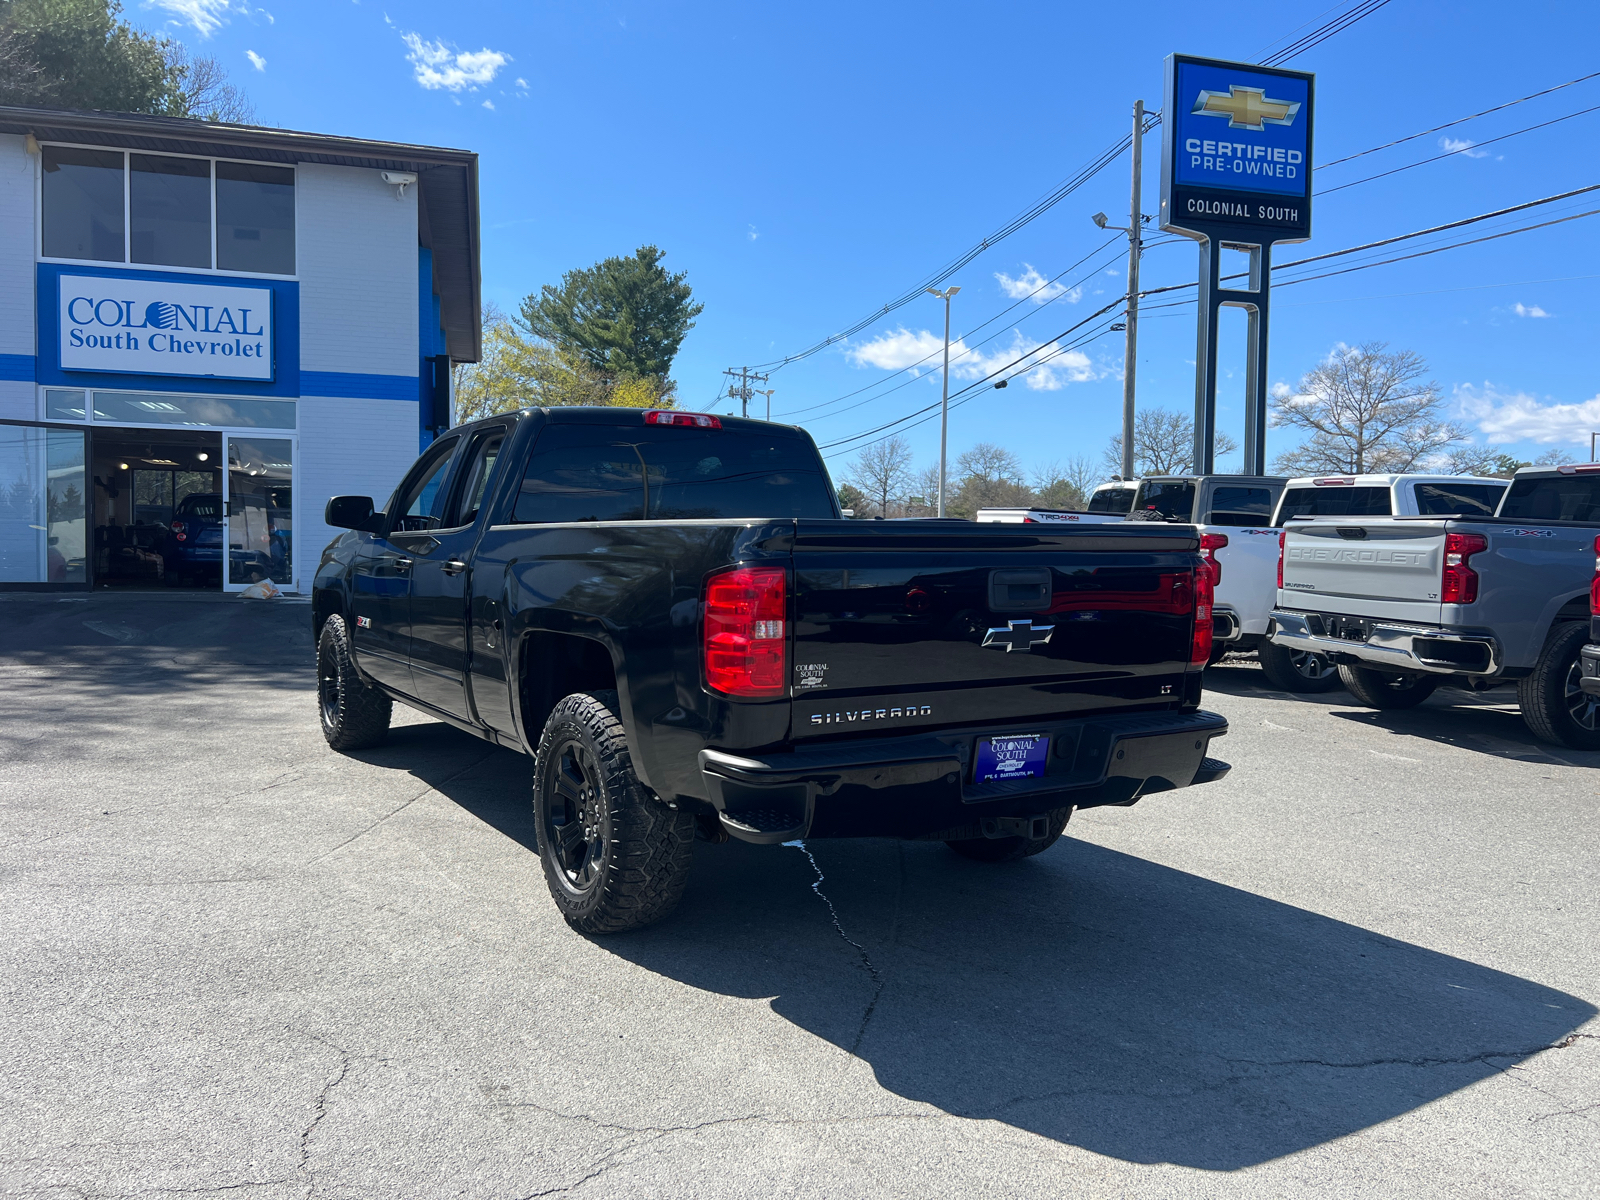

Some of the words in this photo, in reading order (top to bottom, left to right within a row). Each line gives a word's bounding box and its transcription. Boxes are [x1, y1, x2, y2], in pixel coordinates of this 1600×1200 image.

[1185, 138, 1303, 164] CERTIFIED
[1191, 155, 1297, 179] PRE-OWNED
[1187, 198, 1251, 218] COLONIAL
[1258, 205, 1298, 222] SOUTH
[67, 297, 264, 336] COLONIAL
[69, 328, 140, 351] South
[148, 333, 264, 358] Chevrolet
[1289, 548, 1427, 565] CHEVROLET
[795, 663, 830, 671] COLONIAL
[800, 670, 824, 678] SOUTH
[1161, 684, 1172, 694] LT
[810, 705, 932, 725] SILVERADO
[991, 741, 1035, 752] COLONIAL
[996, 750, 1027, 761] SOUTH
